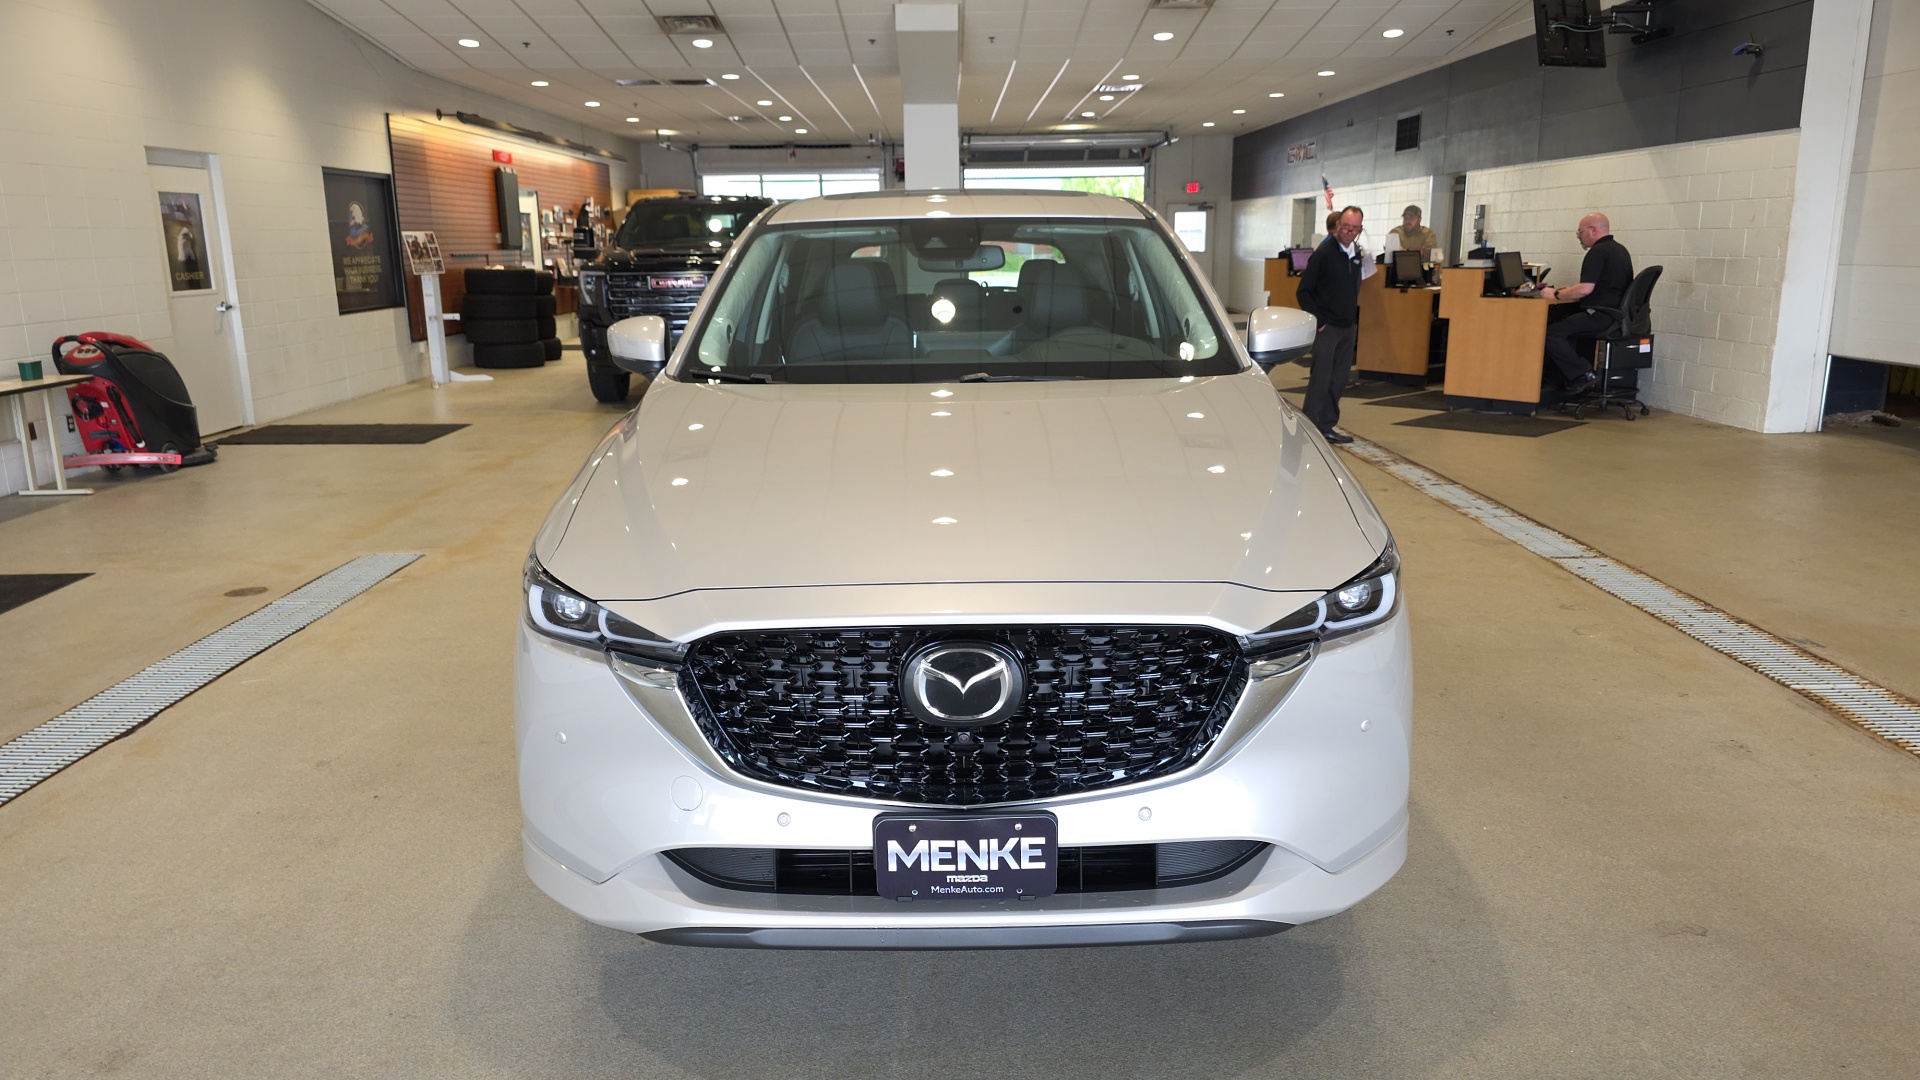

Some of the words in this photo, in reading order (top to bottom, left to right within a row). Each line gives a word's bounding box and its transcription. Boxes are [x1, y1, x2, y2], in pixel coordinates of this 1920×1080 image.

[1287, 140, 1317, 164] GMC
[342, 256, 351, 265] WE
[352, 255, 382, 265] APPRECIATE
[344, 266, 358, 275] YOUR
[175, 271, 204, 281] CASHIER
[350, 275, 367, 284] THANK
[651, 277, 705, 289] GMC
[887, 837, 1046, 872] MENKE
[946, 874, 988, 883] mazda
[931, 885, 1004, 894] MenkeAuto.com
